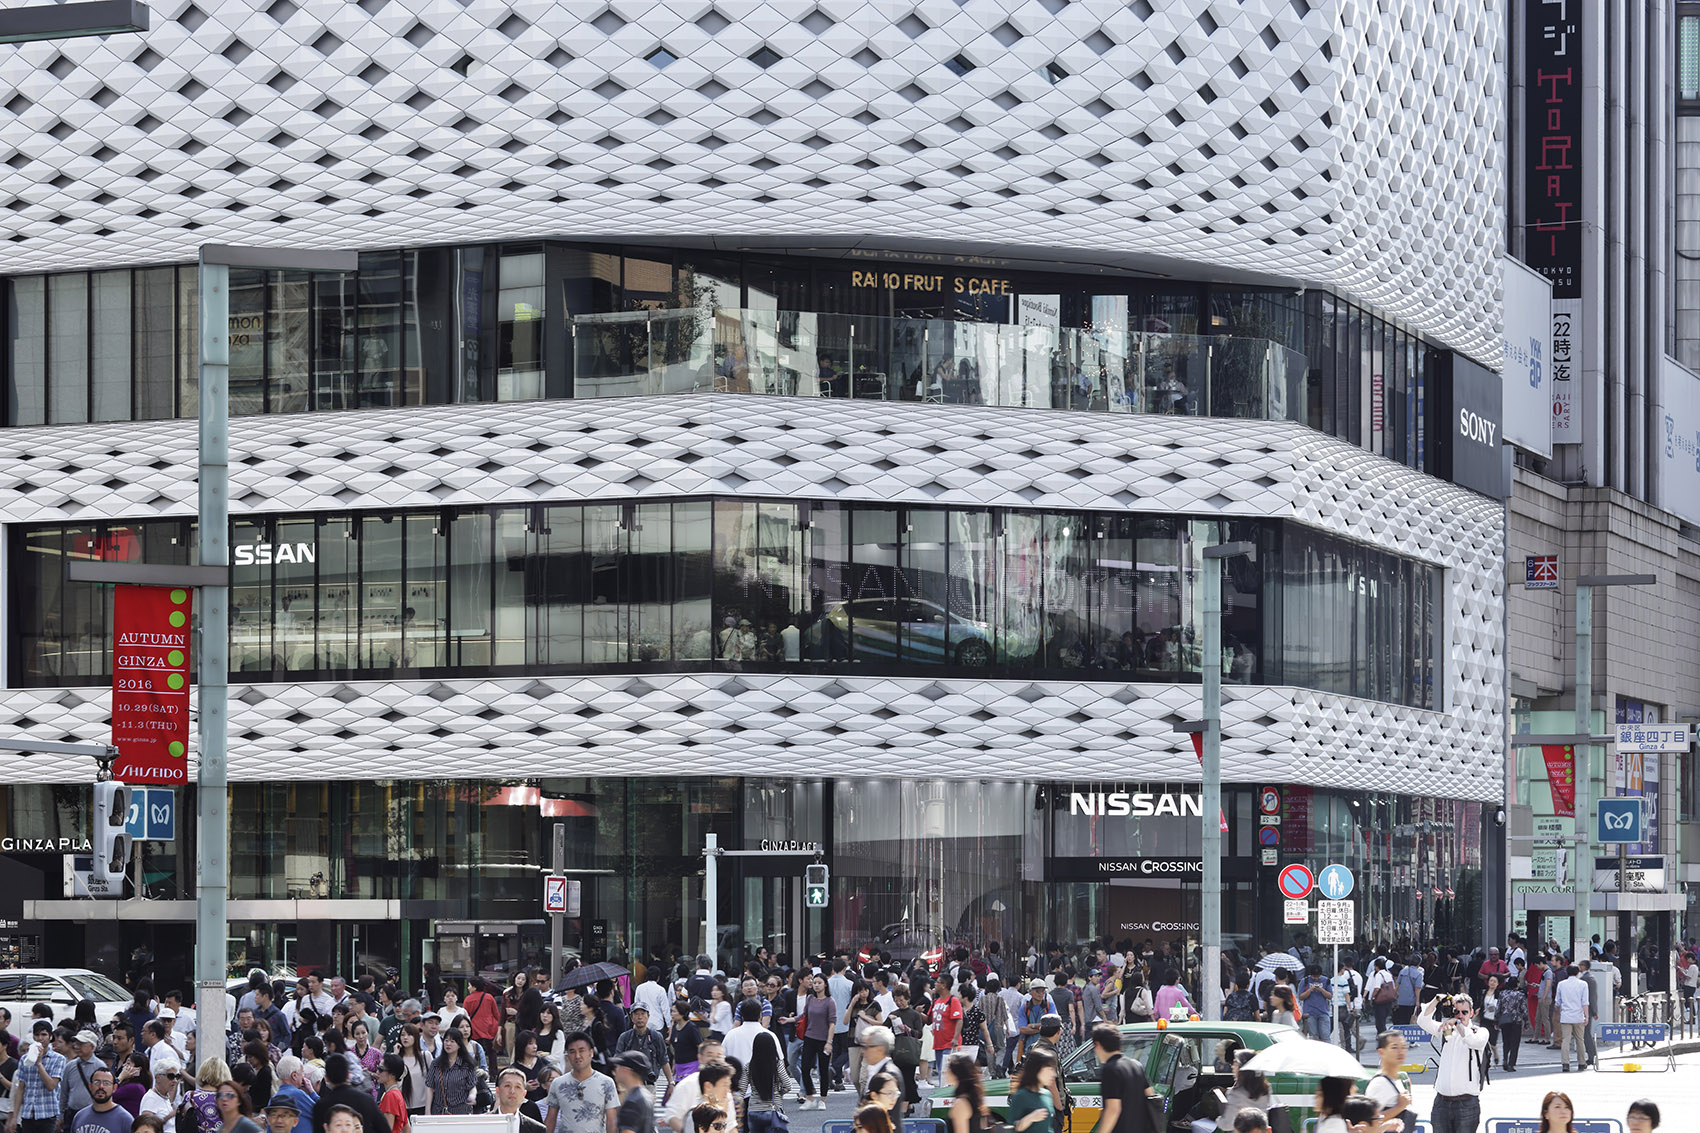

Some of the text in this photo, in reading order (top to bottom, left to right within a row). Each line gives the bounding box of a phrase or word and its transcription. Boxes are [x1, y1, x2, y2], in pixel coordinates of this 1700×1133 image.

[968, 278, 1010, 296] CAFE
[1460, 407, 1496, 448] SONY
[229, 543, 315, 566] SSAN
[118, 632, 185, 645] AUTUMN
[118, 655, 166, 667] GINZA
[118, 679, 153, 690] 2016
[118, 703, 179, 714] 10.29(SAT)
[1620, 731, 1685, 743] 銀座四丁目
[117, 764, 183, 779] SHISEIDO
[1071, 792, 1203, 817] NISSAN
[1, 838, 92, 850] GINZA PLA
[761, 839, 817, 851] GINZA PLACE
[1098, 862, 1137, 871] NISSAN
[1152, 921, 1200, 931] CROSSING
